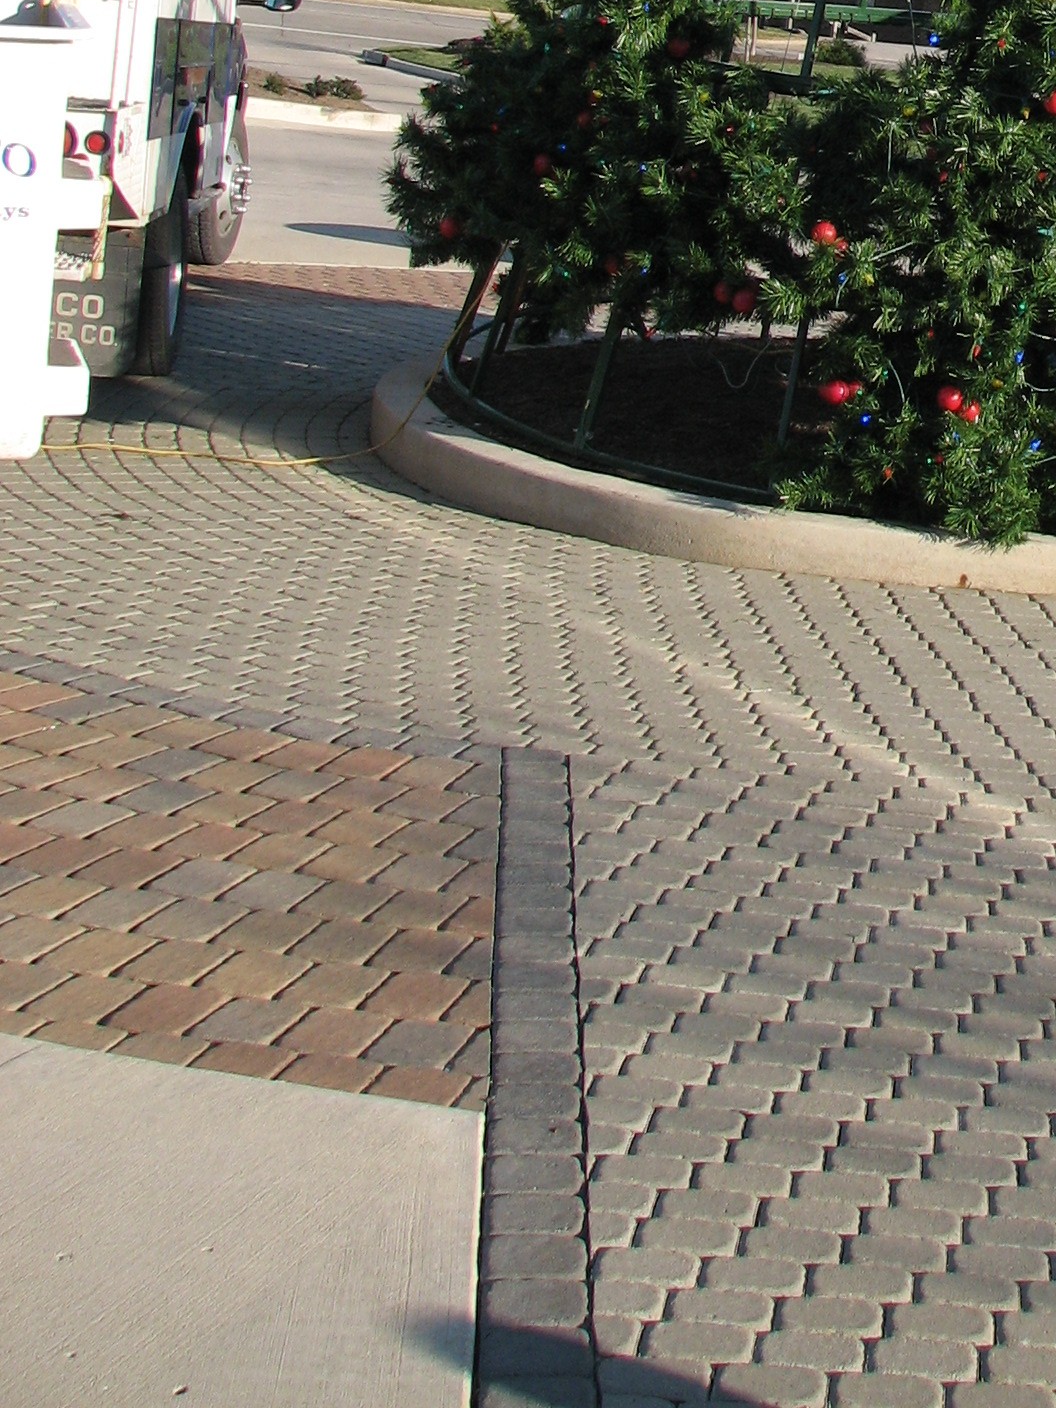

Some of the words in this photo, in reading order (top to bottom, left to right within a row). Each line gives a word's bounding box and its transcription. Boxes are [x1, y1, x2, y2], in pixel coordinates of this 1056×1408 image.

[0, 140, 37, 177] O
[0, 206, 30, 221] ys
[80, 324, 118, 347] CO.
